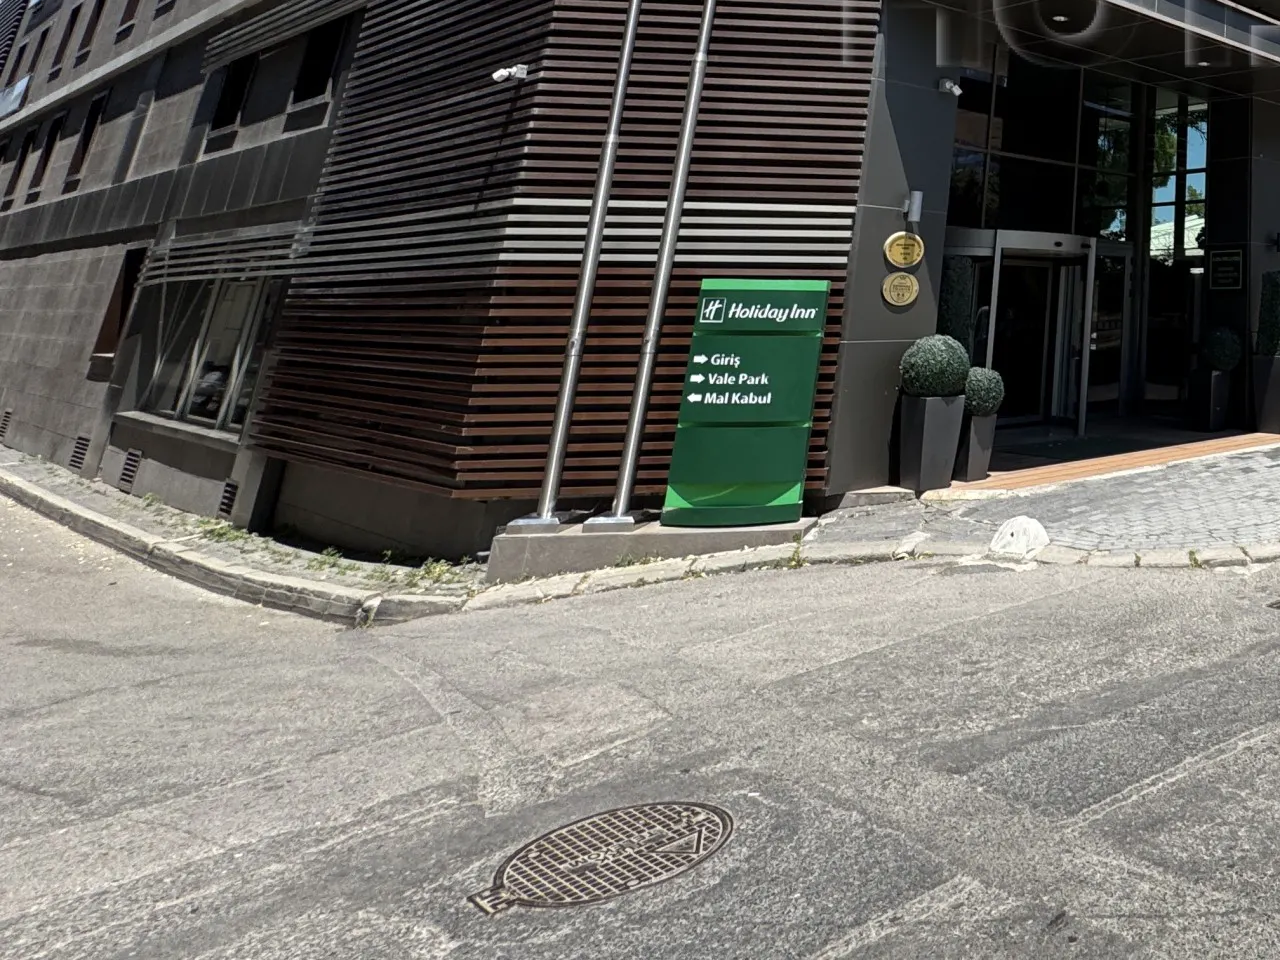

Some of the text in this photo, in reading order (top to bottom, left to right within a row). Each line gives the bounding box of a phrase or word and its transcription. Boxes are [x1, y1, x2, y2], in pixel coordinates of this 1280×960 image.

[728, 302, 790, 323] Holiday
[789, 303, 816, 319] Inn
[710, 353, 741, 369] Giriş
[708, 372, 769, 385] Vale Park
[704, 391, 772, 405] Mal Kabul
